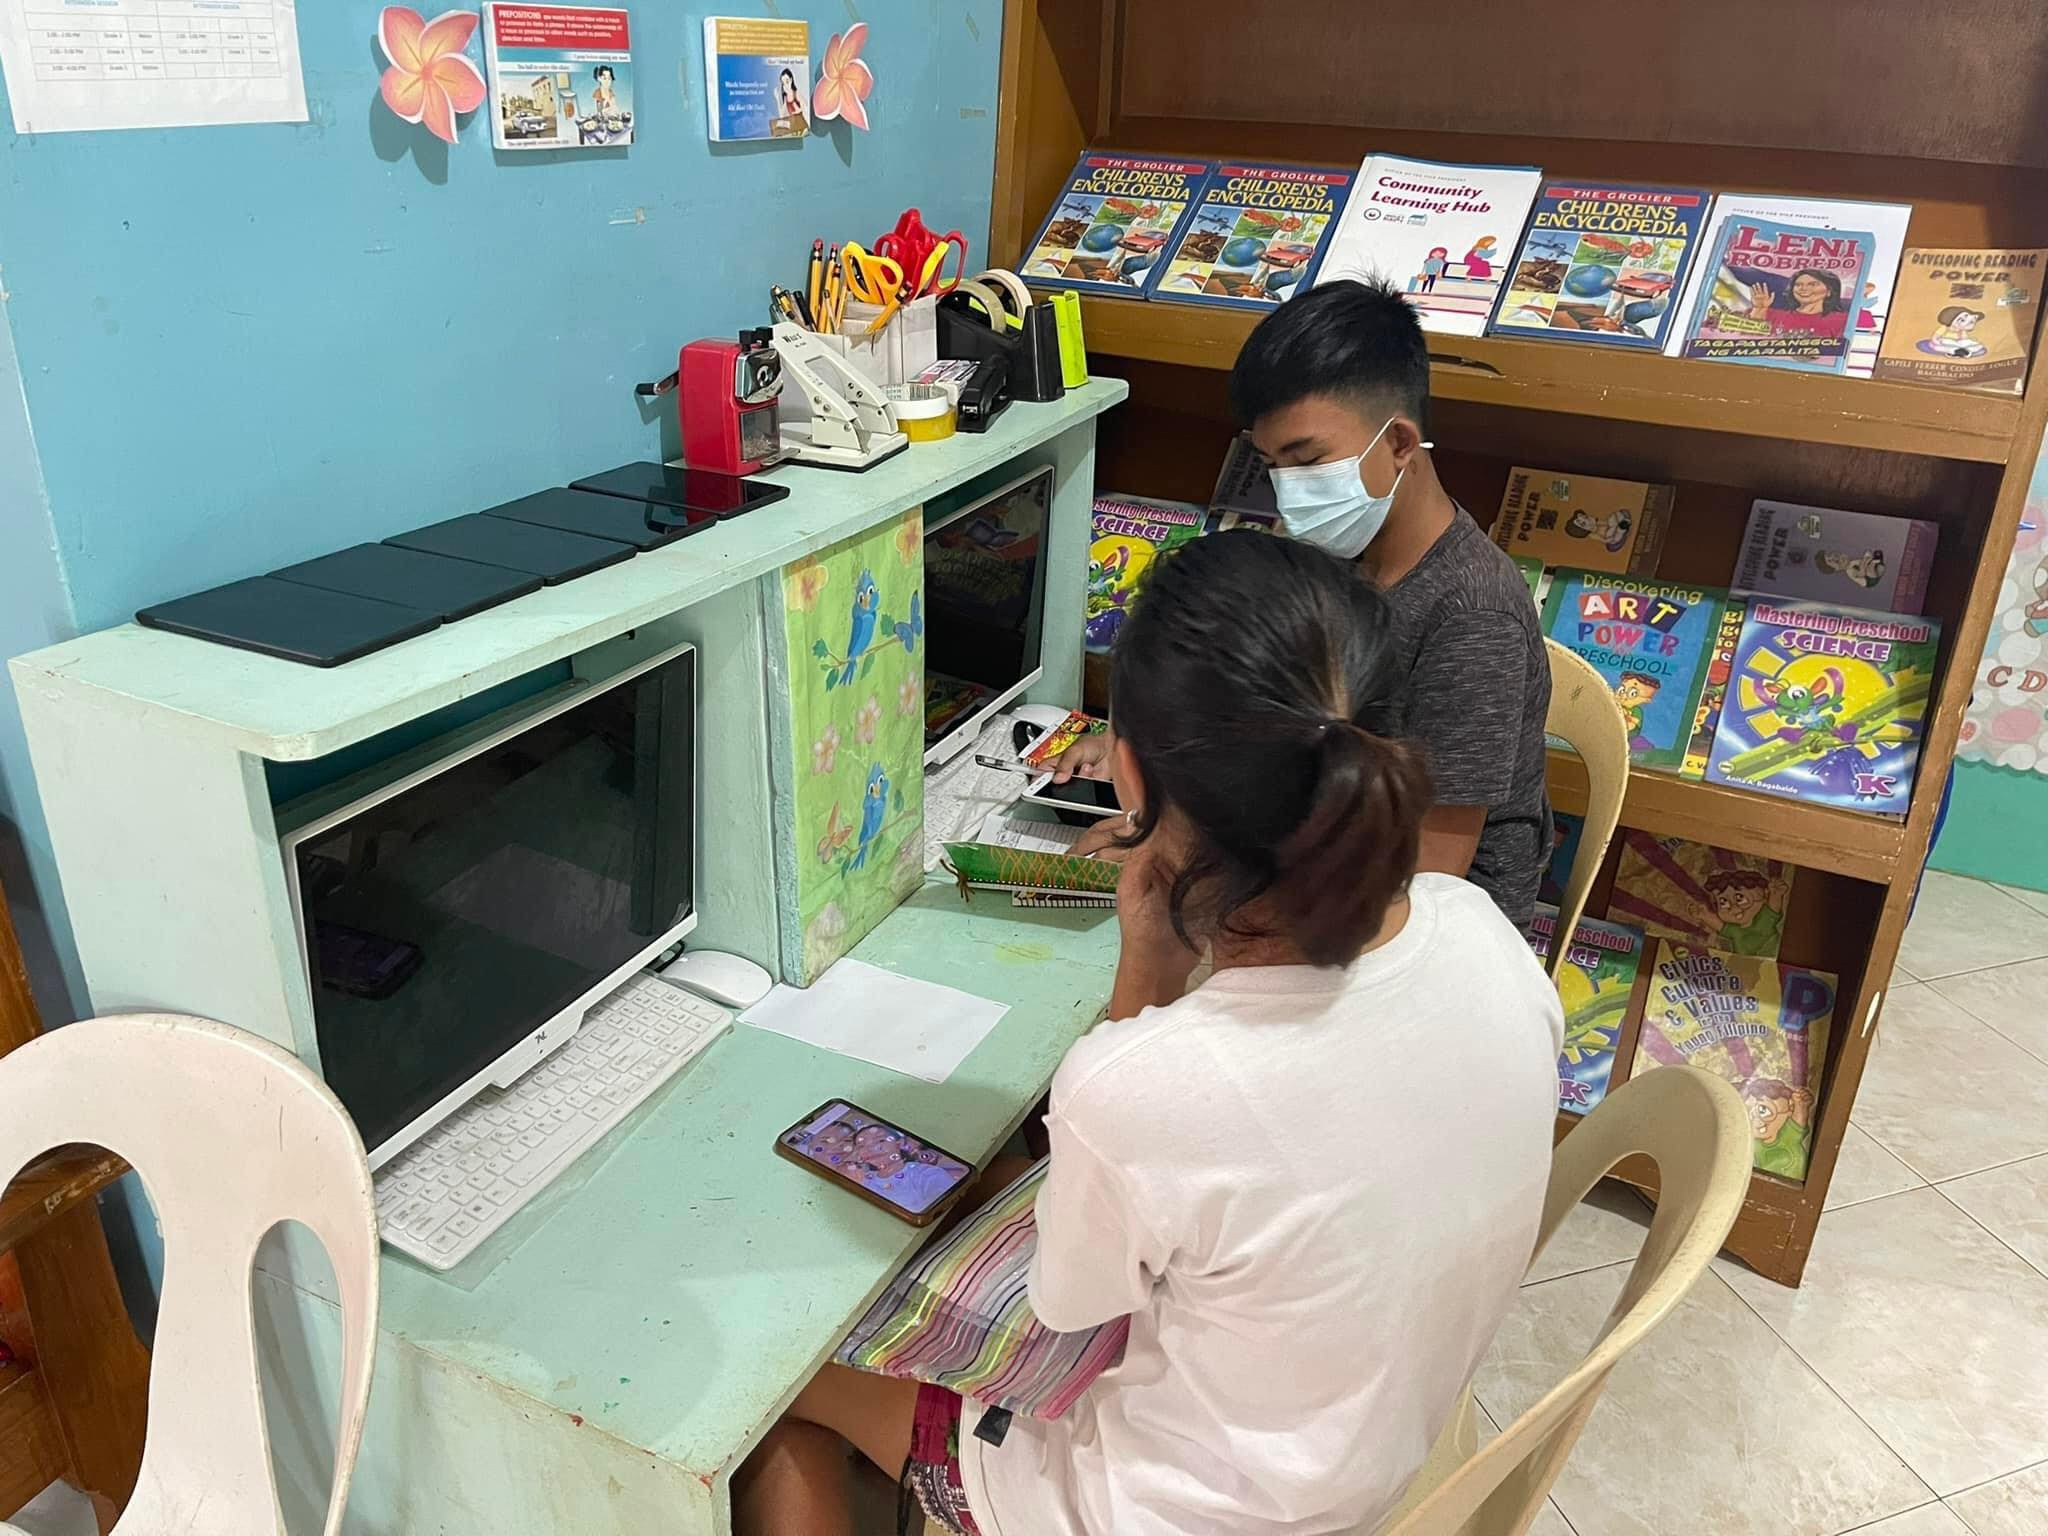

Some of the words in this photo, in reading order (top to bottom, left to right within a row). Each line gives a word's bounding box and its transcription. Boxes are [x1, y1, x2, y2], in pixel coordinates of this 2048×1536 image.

[1092, 168, 1187, 187] CHILDREN'S
[1107, 159, 1131, 168] THE
[1134, 161, 1185, 172] GROLIER
[1242, 169, 1265, 178] THE
[1268, 171, 1326, 182] GROLIER
[1071, 179, 1191, 200] ENCYCLOPEDIA
[1227, 178, 1330, 198] CHILDREN'S
[1378, 176, 1484, 200] Community
[1573, 190, 1600, 198] THE
[1607, 192, 1673, 203] GROLIER
[1205, 190, 1335, 213] ENCYCLOPEDIA
[1370, 191, 1451, 213] Learning
[1451, 200, 1491, 214] Hub
[1557, 199, 1678, 220] CHILDREN'S
[1534, 212, 1688, 236] ENCYCLOPEDIA
[1733, 224, 1858, 257] LENI
[1728, 251, 1857, 270] ROBREDO
[1911, 253, 1980, 268] DEVELOPING
[1984, 254, 2037, 268] READING
[1929, 270, 2011, 282] POWER
[1694, 338, 1841, 348] TAGAPAGTANGGOL
[1706, 348, 1731, 356] NG
[1733, 347, 1821, 356] MARALITA
[1094, 500, 1138, 519] stering
[1138, 504, 1199, 526] Preschool
[1093, 514, 1169, 541] SCIENCE
[1583, 574, 1704, 605] Discovering
[1583, 595, 1678, 624] ART
[1754, 604, 1839, 634] Mastering
[1839, 616, 1930, 643] Preschool
[1578, 623, 1680, 656] POWER
[1781, 630, 1891, 660] SCIENCE
[1987, 666, 2012, 687] C
[2017, 670, 2048, 692] D
[1856, 774, 1896, 796] K
[1574, 927, 1634, 953] eschool
[1658, 956, 1729, 982] Civics,
[1660, 974, 1743, 1004] Culture
[1778, 970, 1835, 1031] P
[1665, 1008, 1683, 1027] &
[1684, 995, 1758, 1018] Values
[1674, 1028, 1716, 1056] Young
[1559, 1078, 1592, 1104] K
